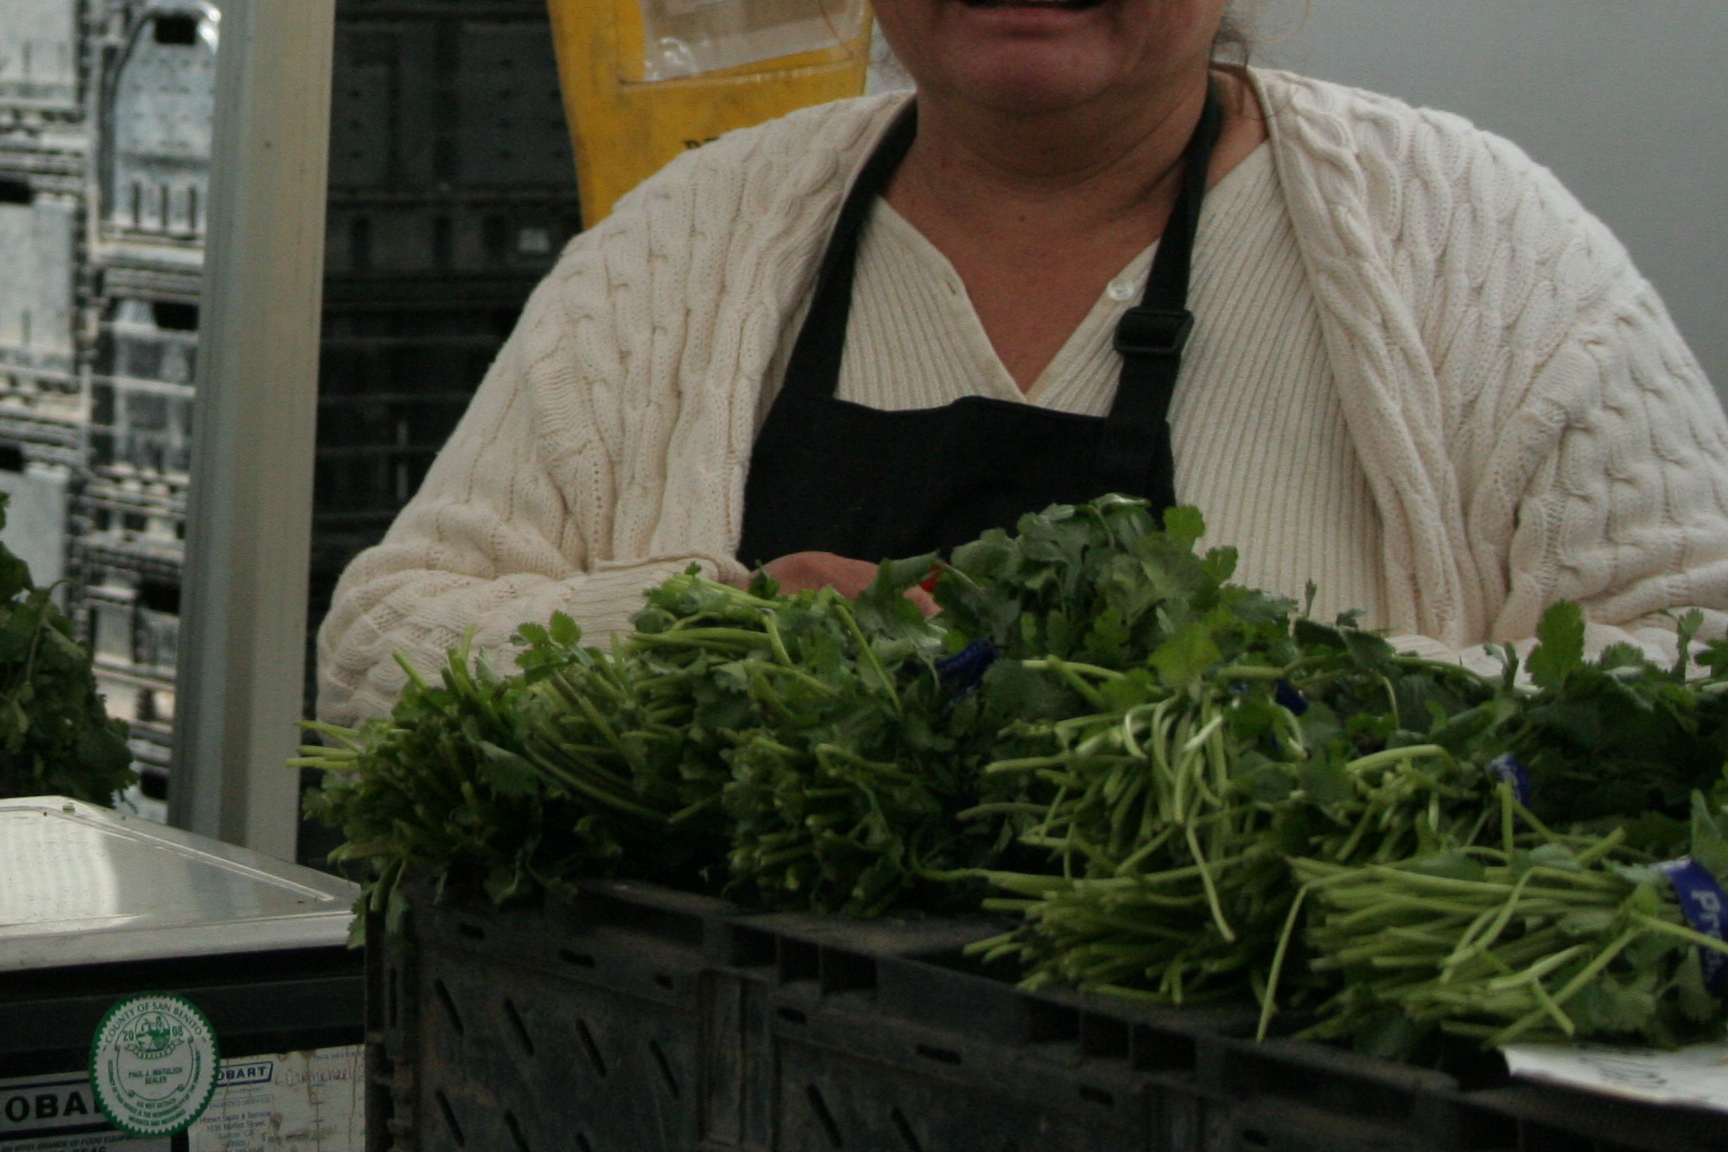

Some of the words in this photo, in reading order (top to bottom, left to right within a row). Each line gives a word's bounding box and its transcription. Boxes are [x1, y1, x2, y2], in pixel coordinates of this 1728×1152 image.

[106, 1008, 135, 1043] COUNTY
[137, 1004, 150, 1012] OF
[152, 1002, 172, 1012] SAN
[173, 1007, 203, 1035] BENITO
[123, 1029, 135, 1041] 20
